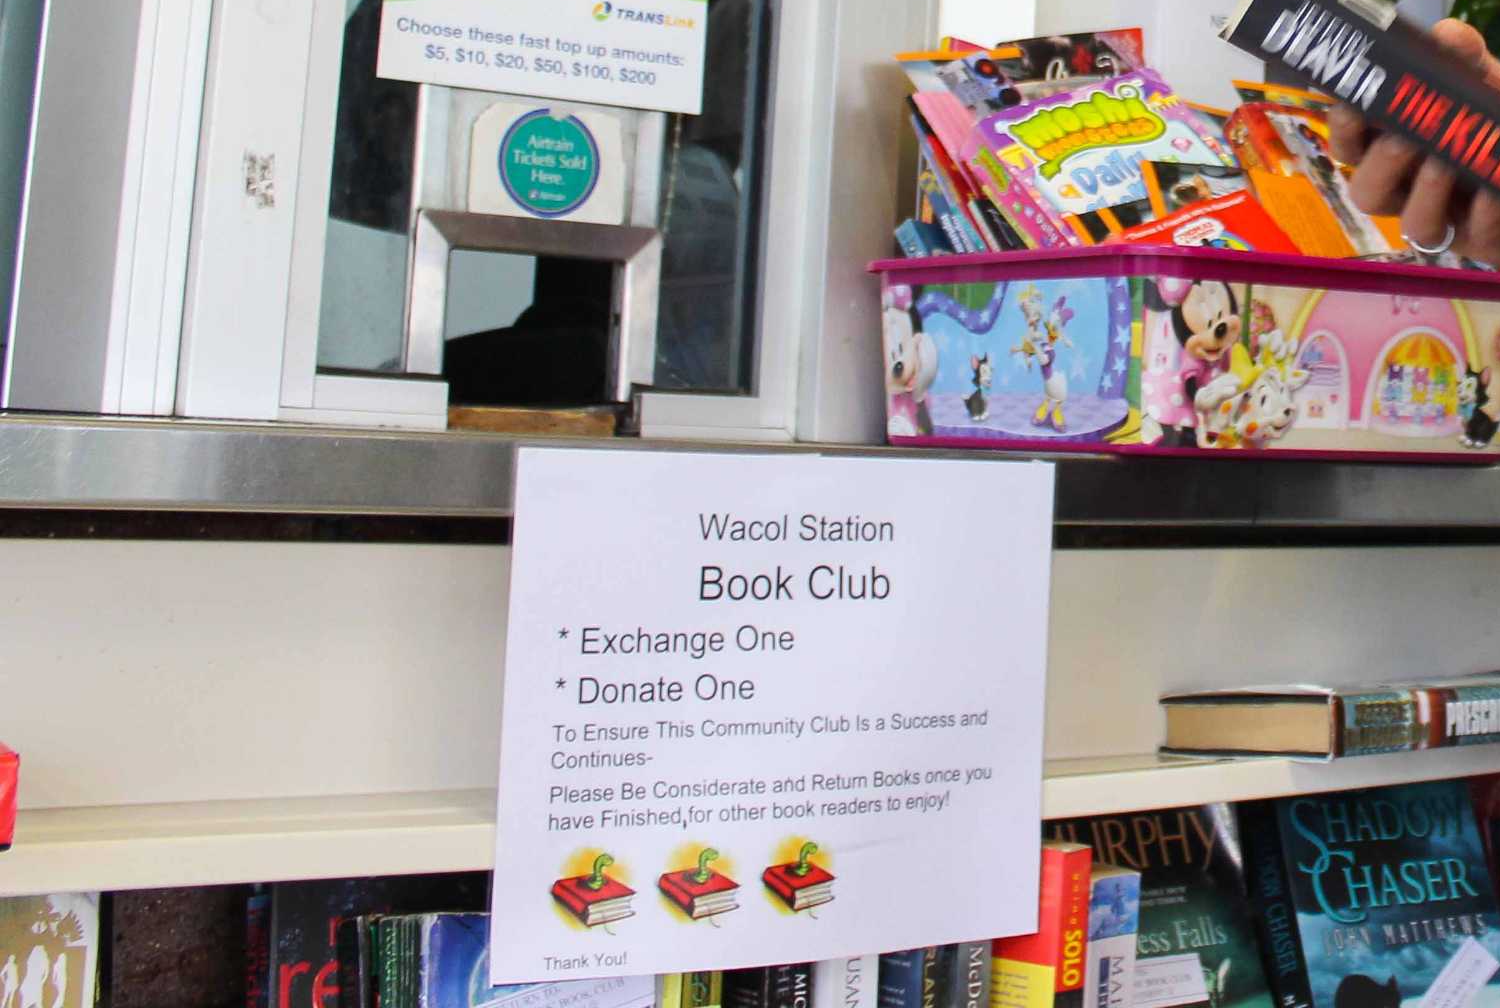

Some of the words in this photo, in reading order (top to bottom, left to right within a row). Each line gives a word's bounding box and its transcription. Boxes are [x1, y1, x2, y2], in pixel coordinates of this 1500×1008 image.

[397, 17, 462, 41] Choose
[468, 25, 515, 48] these
[519, 31, 552, 52] fast
[555, 36, 582, 59] top
[585, 42, 607, 62] up
[611, 47, 686, 69] amounts:
[424, 44, 451, 65] $5,
[455, 47, 492, 71] $10,
[494, 52, 530, 75] $20,
[533, 56, 569, 80] $50,
[572, 60, 615, 84] $100,
[619, 66, 657, 87] $200
[1263, 8, 1387, 110] DEAVER
[1388, 72, 1453, 141] THE
[513, 149, 556, 168] Tickets
[559, 155, 587, 170] Sold
[699, 513, 788, 541] Wacol
[799, 514, 894, 542] Station
[700, 565, 794, 601] Book
[808, 564, 890, 600] Club
[581, 627, 724, 659] Exchange
[736, 625, 795, 652] One
[578, 677, 683, 705] Donate
[695, 674, 755, 700] One
[552, 724, 577, 742] To
[583, 723, 649, 742] Ensure
[656, 721, 695, 739] This
[701, 719, 804, 738] Community
[810, 715, 850, 733] Club
[856, 714, 869, 732] Is
[875, 717, 885, 731] a
[890, 712, 956, 730] Success
[960, 709, 988, 727] and
[551, 750, 653, 769] Continues-
[550, 785, 614, 804] Please
[621, 782, 646, 800] Be
[653, 779, 766, 799] Considerate
[772, 775, 805, 793] and
[811, 774, 868, 791] Return
[873, 769, 920, 788] Books
[924, 768, 960, 784] once
[966, 767, 992, 784] you
[548, 813, 594, 831] have
[719, 803, 766, 822] other
[772, 801, 815, 819] book
[821, 798, 881, 817] readers
[887, 796, 900, 811] to
[906, 791, 950, 812] enjoy!
[1050, 811, 1218, 871] URPHY
[1290, 794, 1463, 874] SHADOW
[1312, 849, 1480, 924] CHASER
[1174, 916, 1227, 950] Falls
[1382, 913, 1489, 945] MATTHEWS
[544, 955, 589, 971] Thank
[594, 952, 628, 967] You!
[1062, 929, 1082, 986] SOLO
